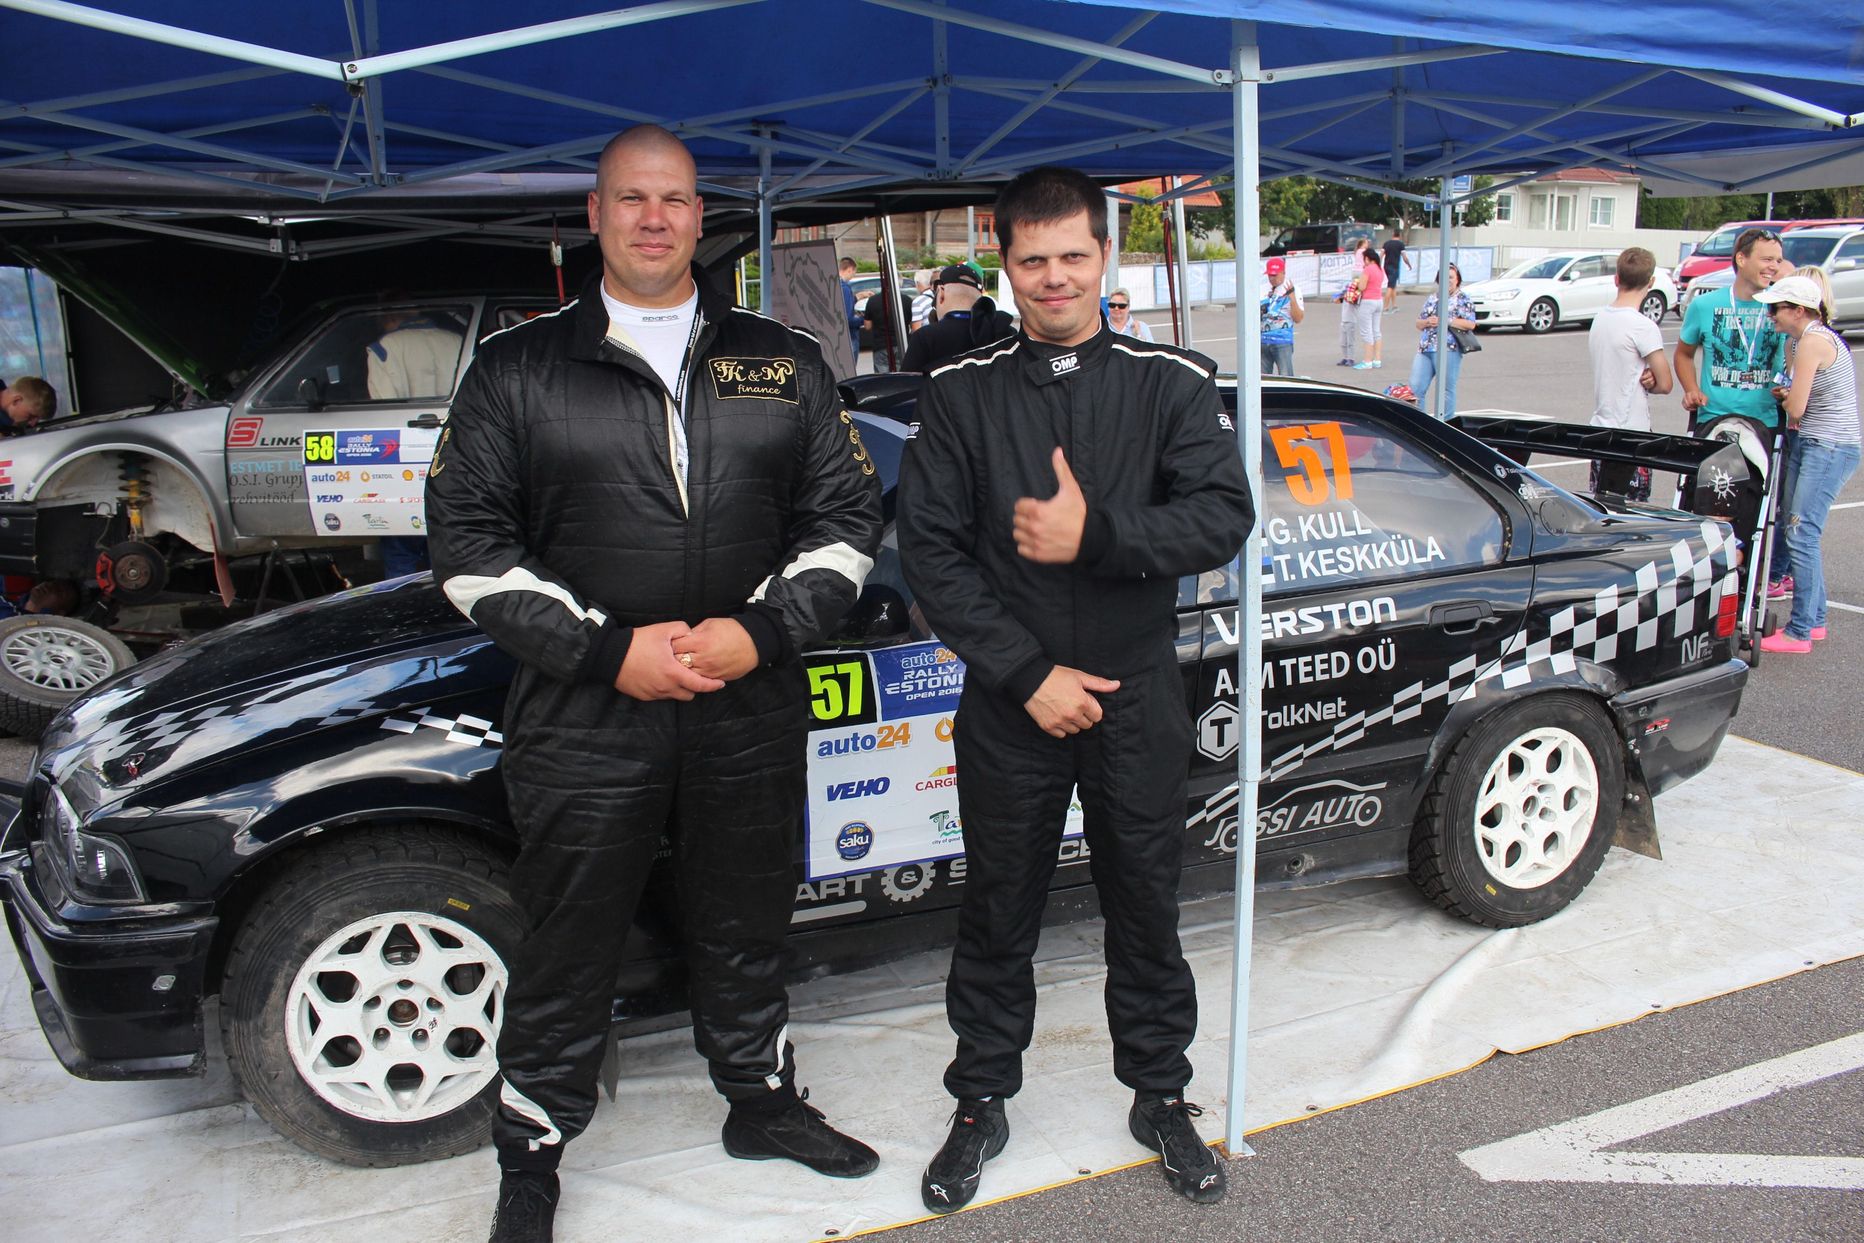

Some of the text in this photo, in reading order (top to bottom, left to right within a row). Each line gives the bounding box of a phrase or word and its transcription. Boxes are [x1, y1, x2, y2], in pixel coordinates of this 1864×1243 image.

[1052, 357, 1078, 373] OMP
[737, 384, 781, 394] finance
[260, 436, 302, 446] LINK
[305, 436, 334, 461] 58
[1269, 422, 1354, 506] 57
[311, 470, 351, 482] auto24
[317, 494, 344, 502] VEHO
[1210, 597, 1397, 645] VERSTON
[902, 648, 957, 669] auto24
[1681, 631, 1709, 665] NF
[904, 664, 958, 680] RALLY
[1279, 651, 1350, 686] TEED
[1357, 637, 1396, 674] OÜ
[806, 661, 863, 720] 57
[885, 673, 963, 694] ESTONI
[906, 690, 935, 701] OPEN
[817, 722, 911, 758] auto24
[827, 777, 890, 802] VEHO
[1299, 794, 1382, 827] AUTO
[840, 834, 869, 848] saku
[795, 870, 918, 903] ART &
